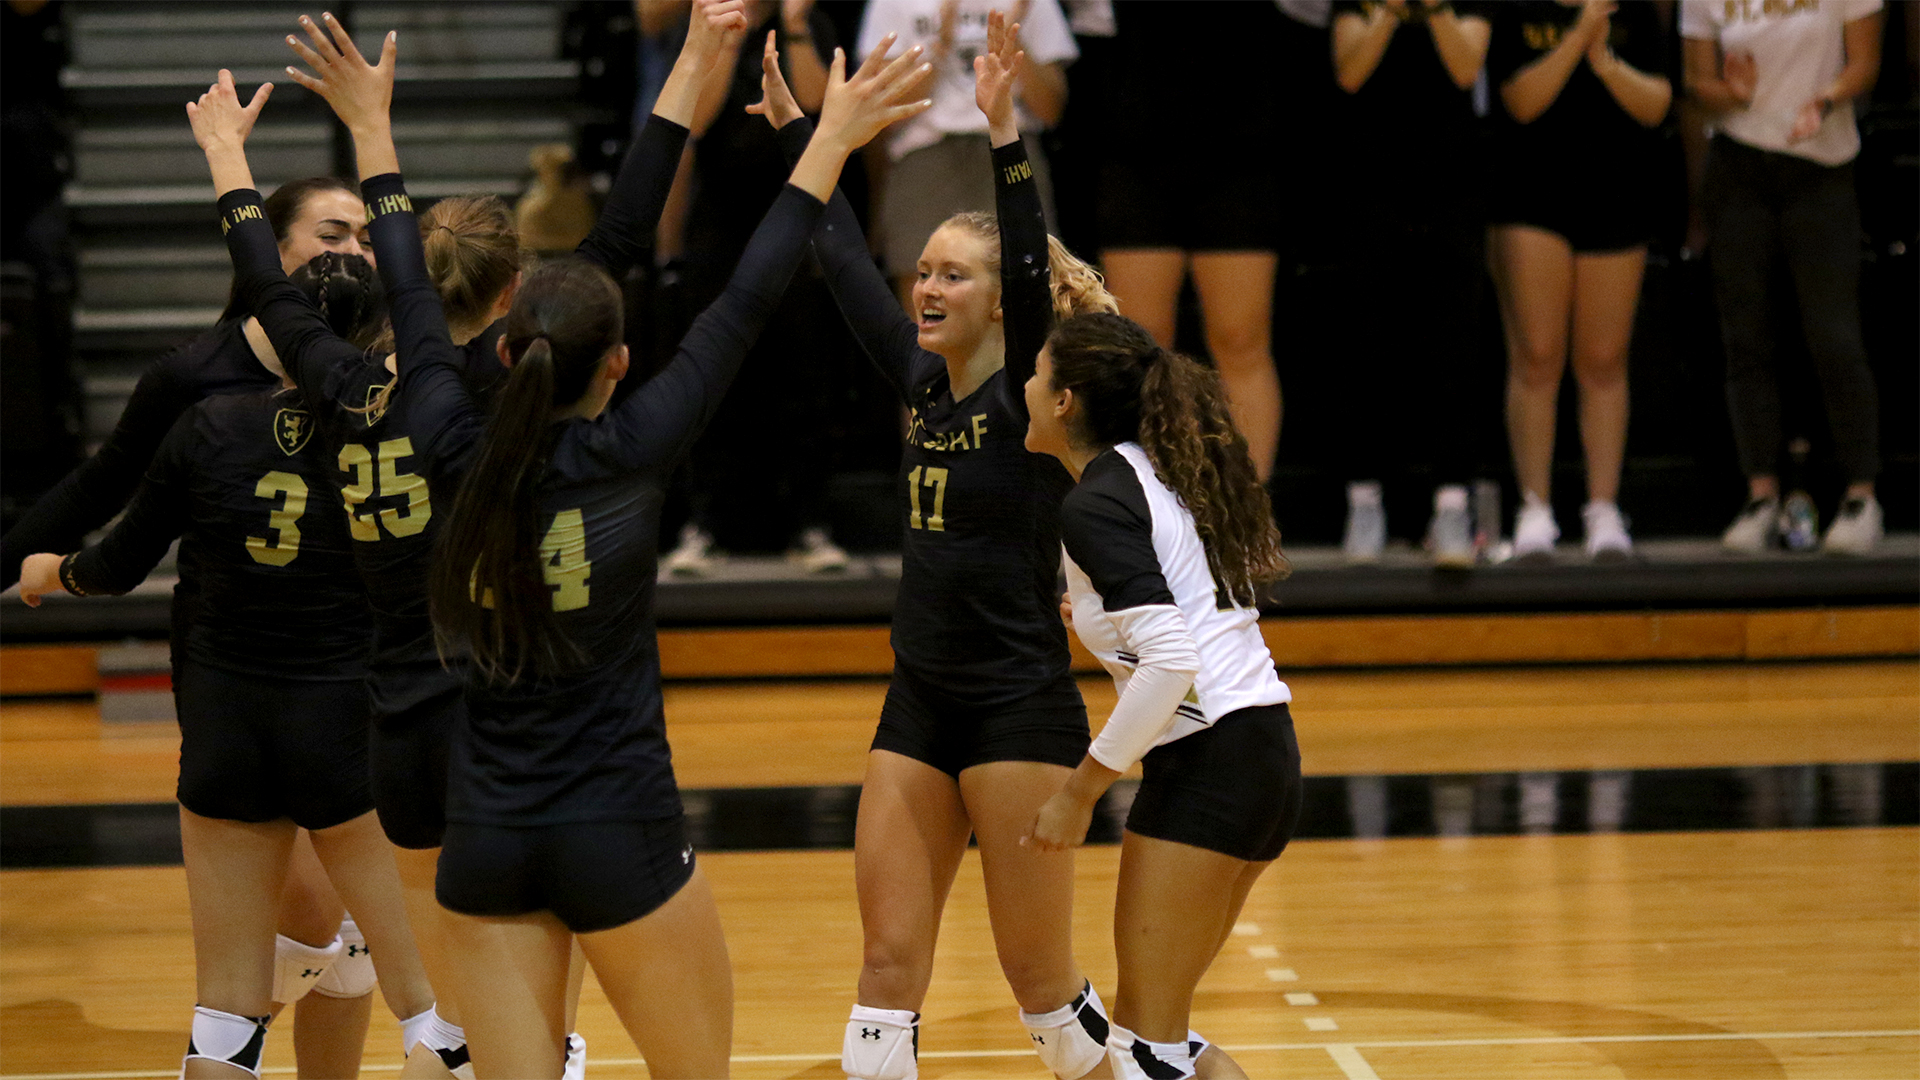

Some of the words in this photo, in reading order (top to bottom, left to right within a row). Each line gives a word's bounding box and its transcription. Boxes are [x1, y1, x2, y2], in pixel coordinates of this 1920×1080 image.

[231, 204, 263, 223] UM!
[378, 194, 414, 215] YAH!
[246, 471, 308, 567] 3
[338, 437, 432, 541] 25
[908, 465, 949, 531] 17
